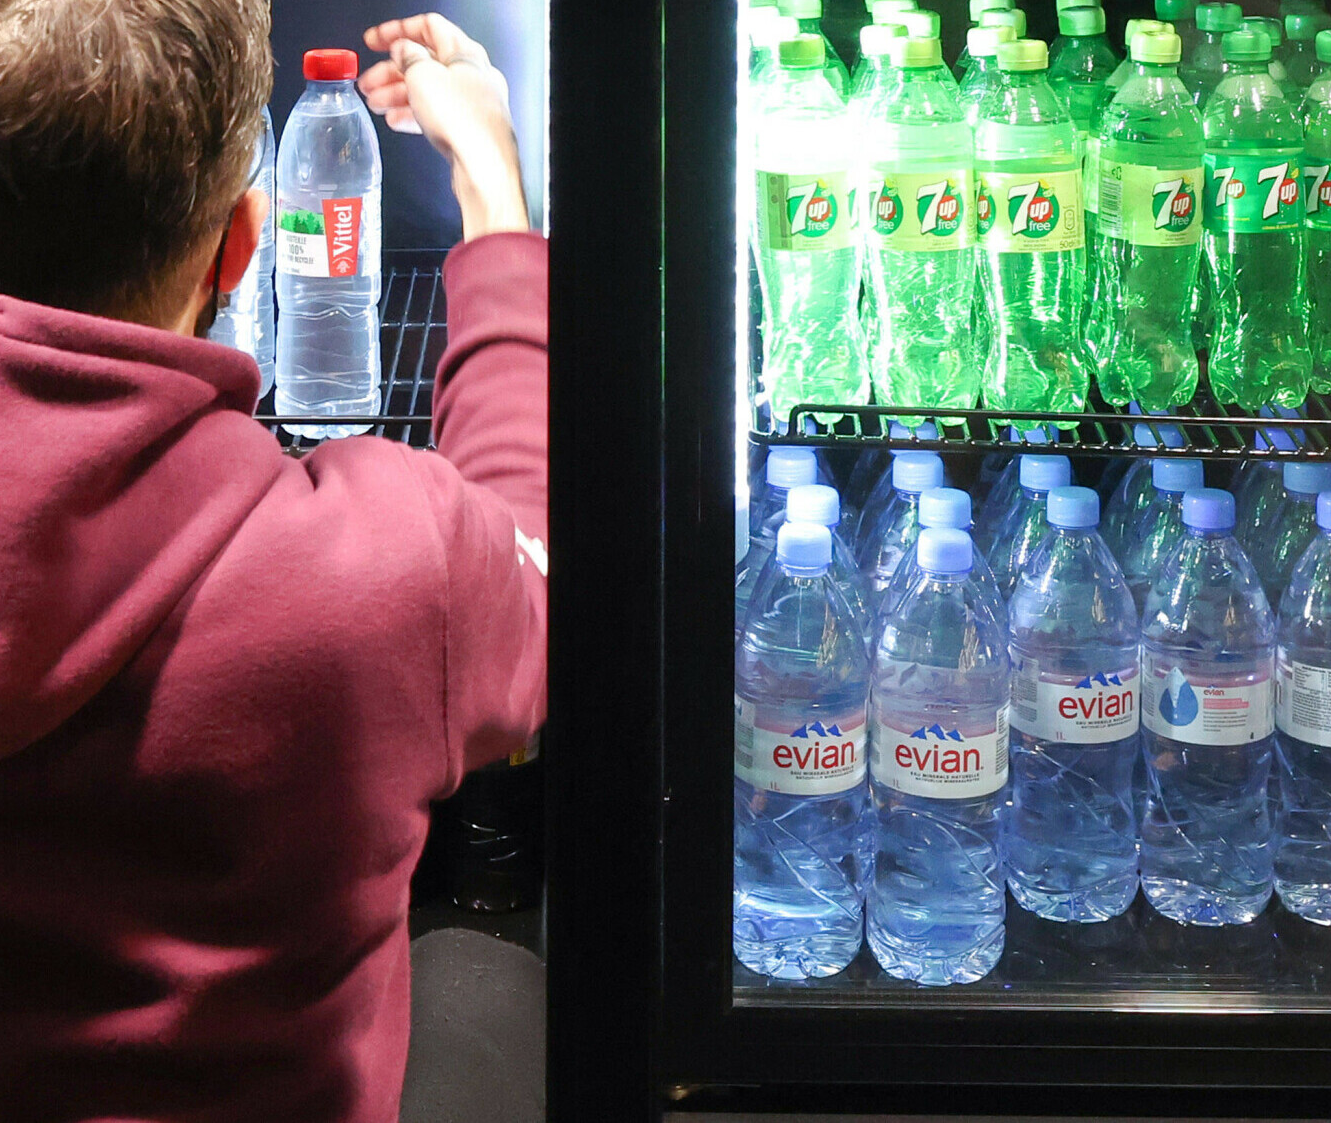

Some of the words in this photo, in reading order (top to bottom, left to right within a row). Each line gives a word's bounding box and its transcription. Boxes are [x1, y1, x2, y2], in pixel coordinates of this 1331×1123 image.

[1213, 167, 1235, 206] 7
[1228, 182, 1243, 197] up
[1258, 163, 1289, 219] 7
[1281, 181, 1296, 206] up
[787, 181, 818, 234] 7
[808, 201, 827, 219] up
[878, 200, 894, 217] up
[917, 180, 947, 235] 7
[938, 199, 956, 218] up
[1009, 181, 1039, 235] 7
[1029, 201, 1050, 219] up
[1154, 179, 1182, 230] 7
[1173, 197, 1190, 217] up
[1171, 214, 1189, 226] free
[332, 204, 353, 257] Vittel
[807, 218, 829, 231] free
[938, 218, 957, 230] free
[1029, 219, 1051, 232] free
[1058, 690, 1133, 720] evian
[1203, 688, 1224, 696] evian
[773, 740, 854, 771] evian
[895, 743, 980, 774] evian
